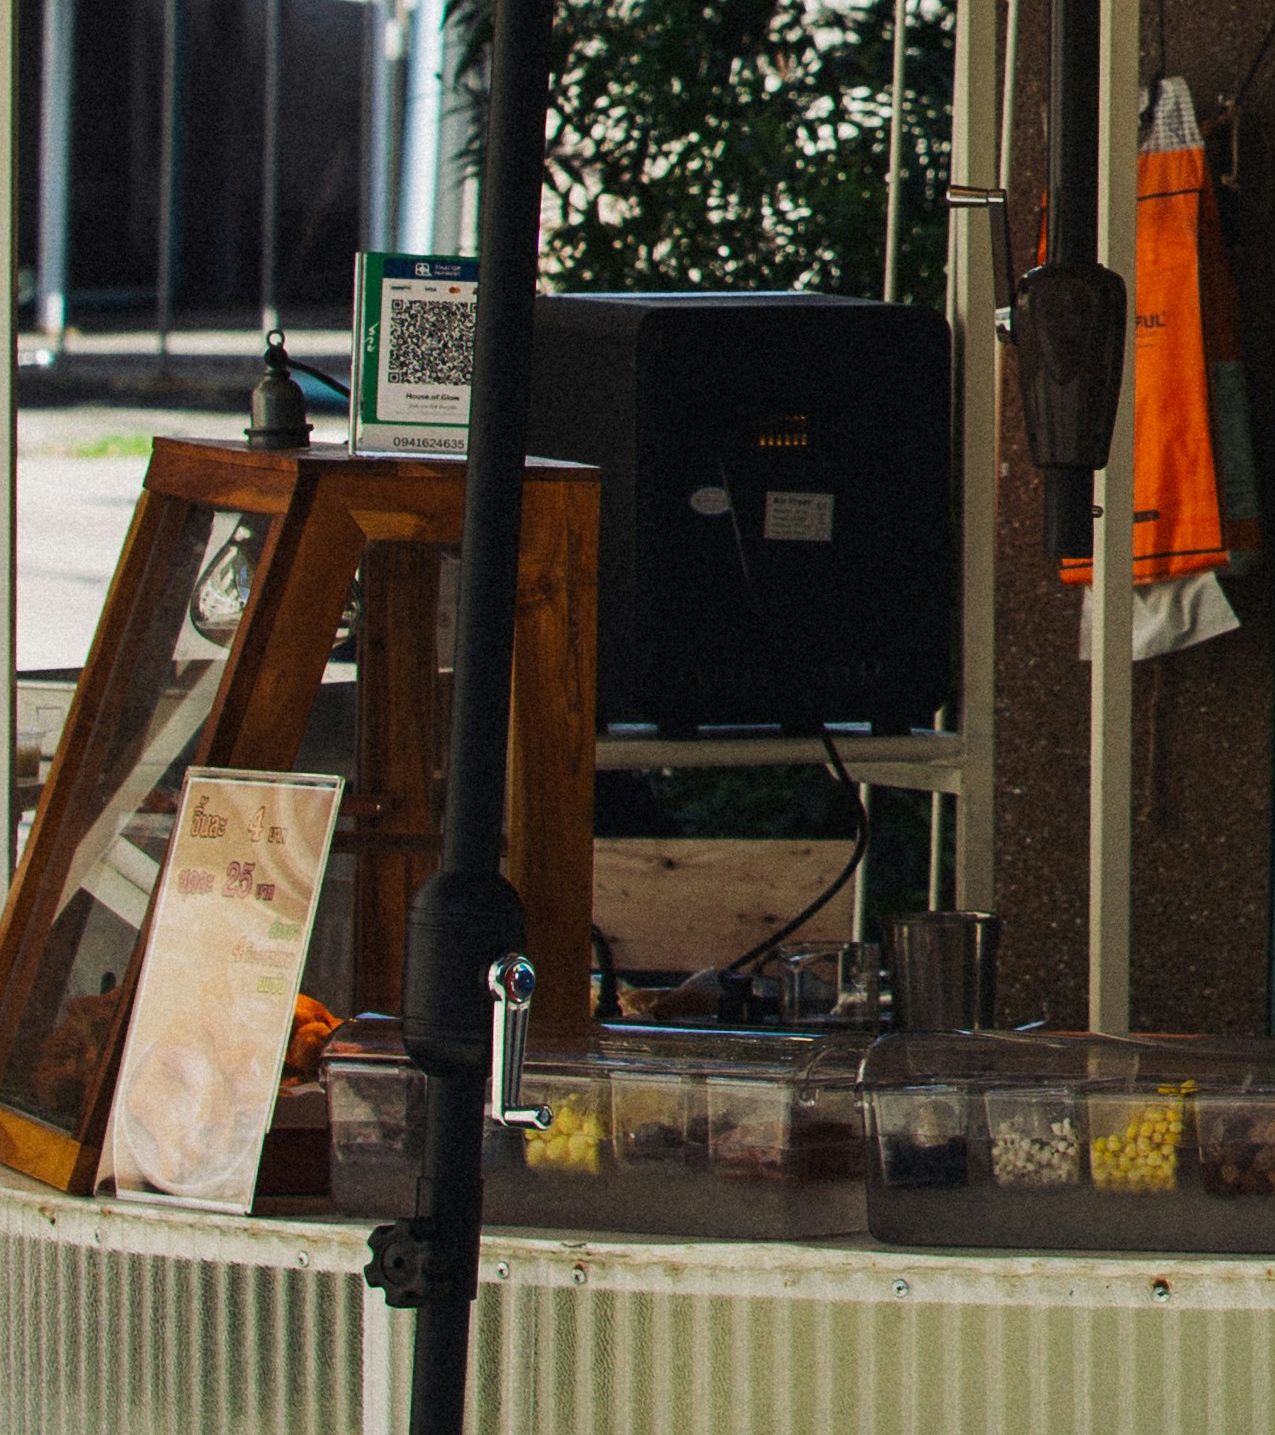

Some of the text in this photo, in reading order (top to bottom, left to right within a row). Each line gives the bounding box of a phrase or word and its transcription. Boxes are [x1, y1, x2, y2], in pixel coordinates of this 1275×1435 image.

[393, 436, 465, 449] 0941624635
[248, 805, 266, 842] 4
[222, 860, 256, 899] 25
